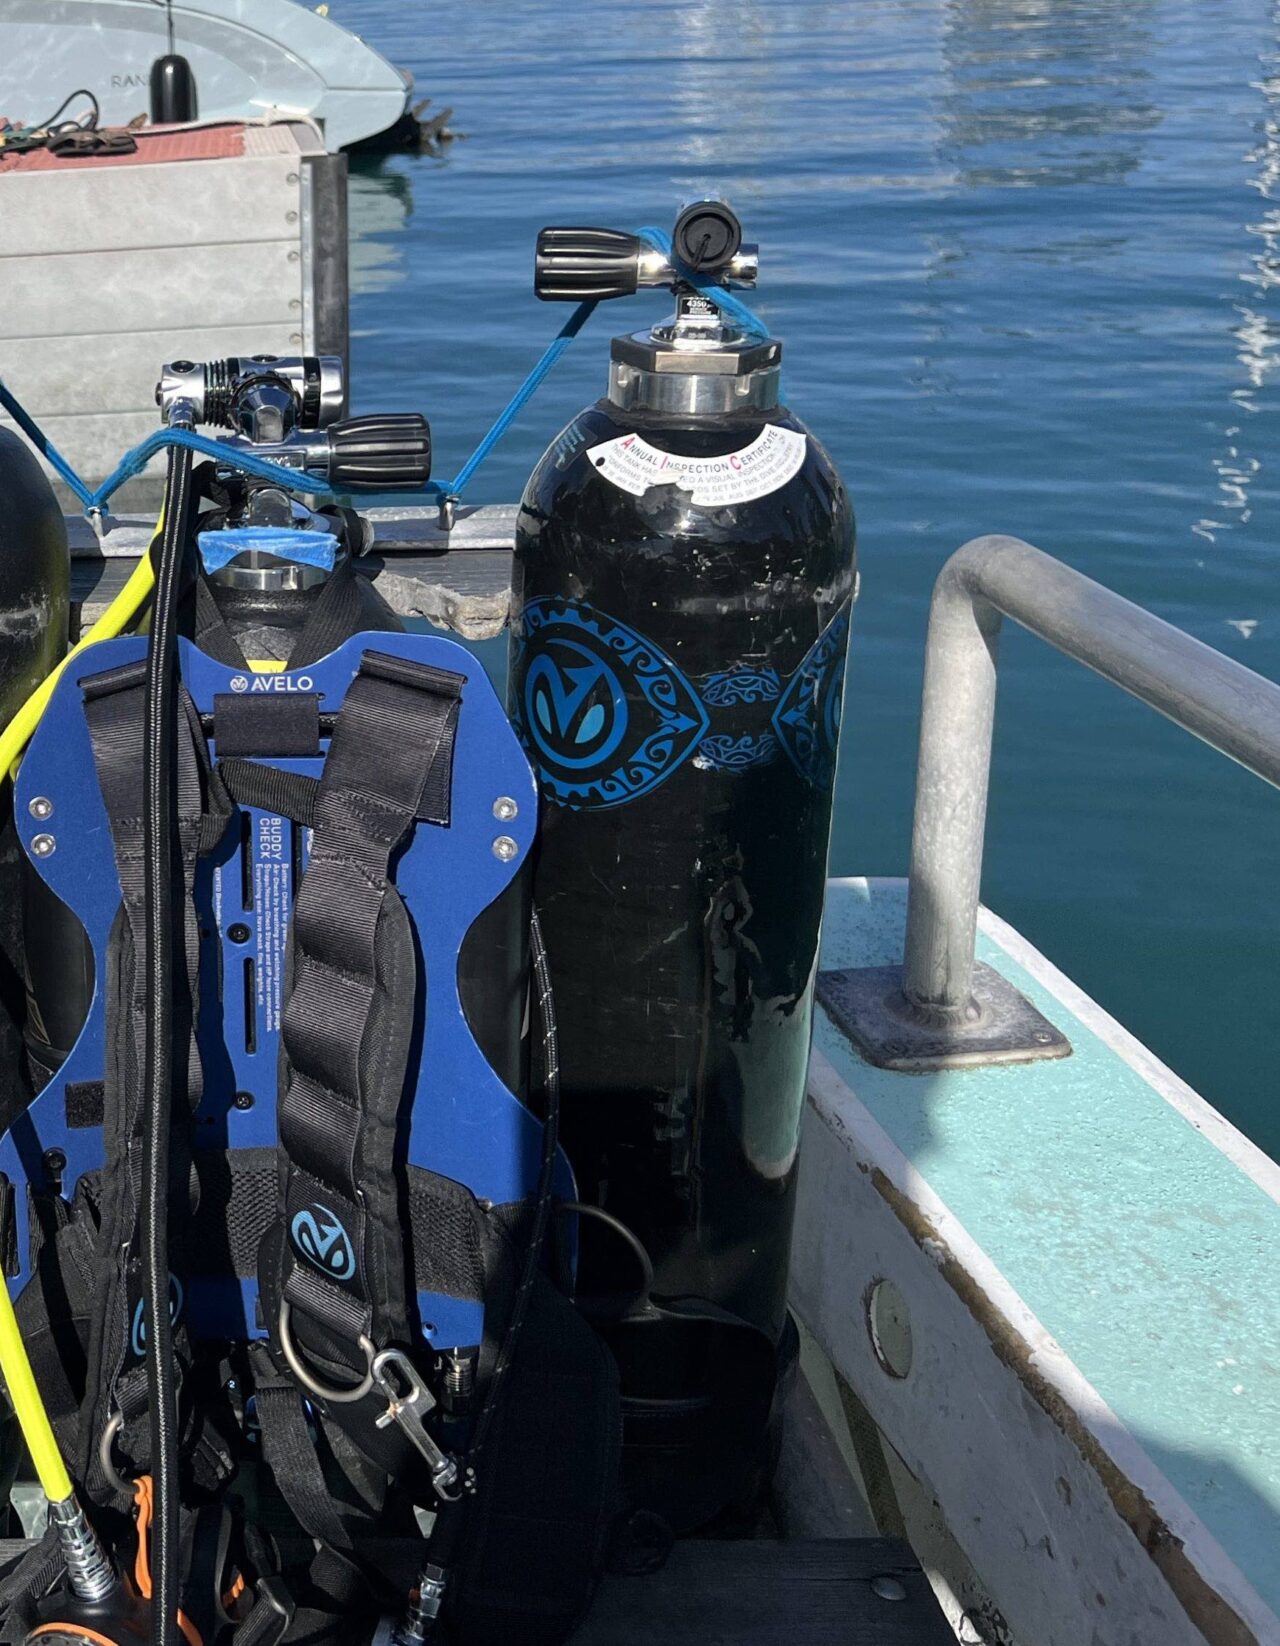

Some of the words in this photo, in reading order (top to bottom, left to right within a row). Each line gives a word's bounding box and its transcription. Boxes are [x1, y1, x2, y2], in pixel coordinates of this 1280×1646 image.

[620, 436, 659, 466] ANNUAL
[660, 456, 729, 474] INSPECTION
[730, 429, 778, 470] CERTIFICATE
[250, 676, 313, 692] AVELO
[260, 818, 271, 859] CHECK
[271, 818, 282, 860] BUDDY
